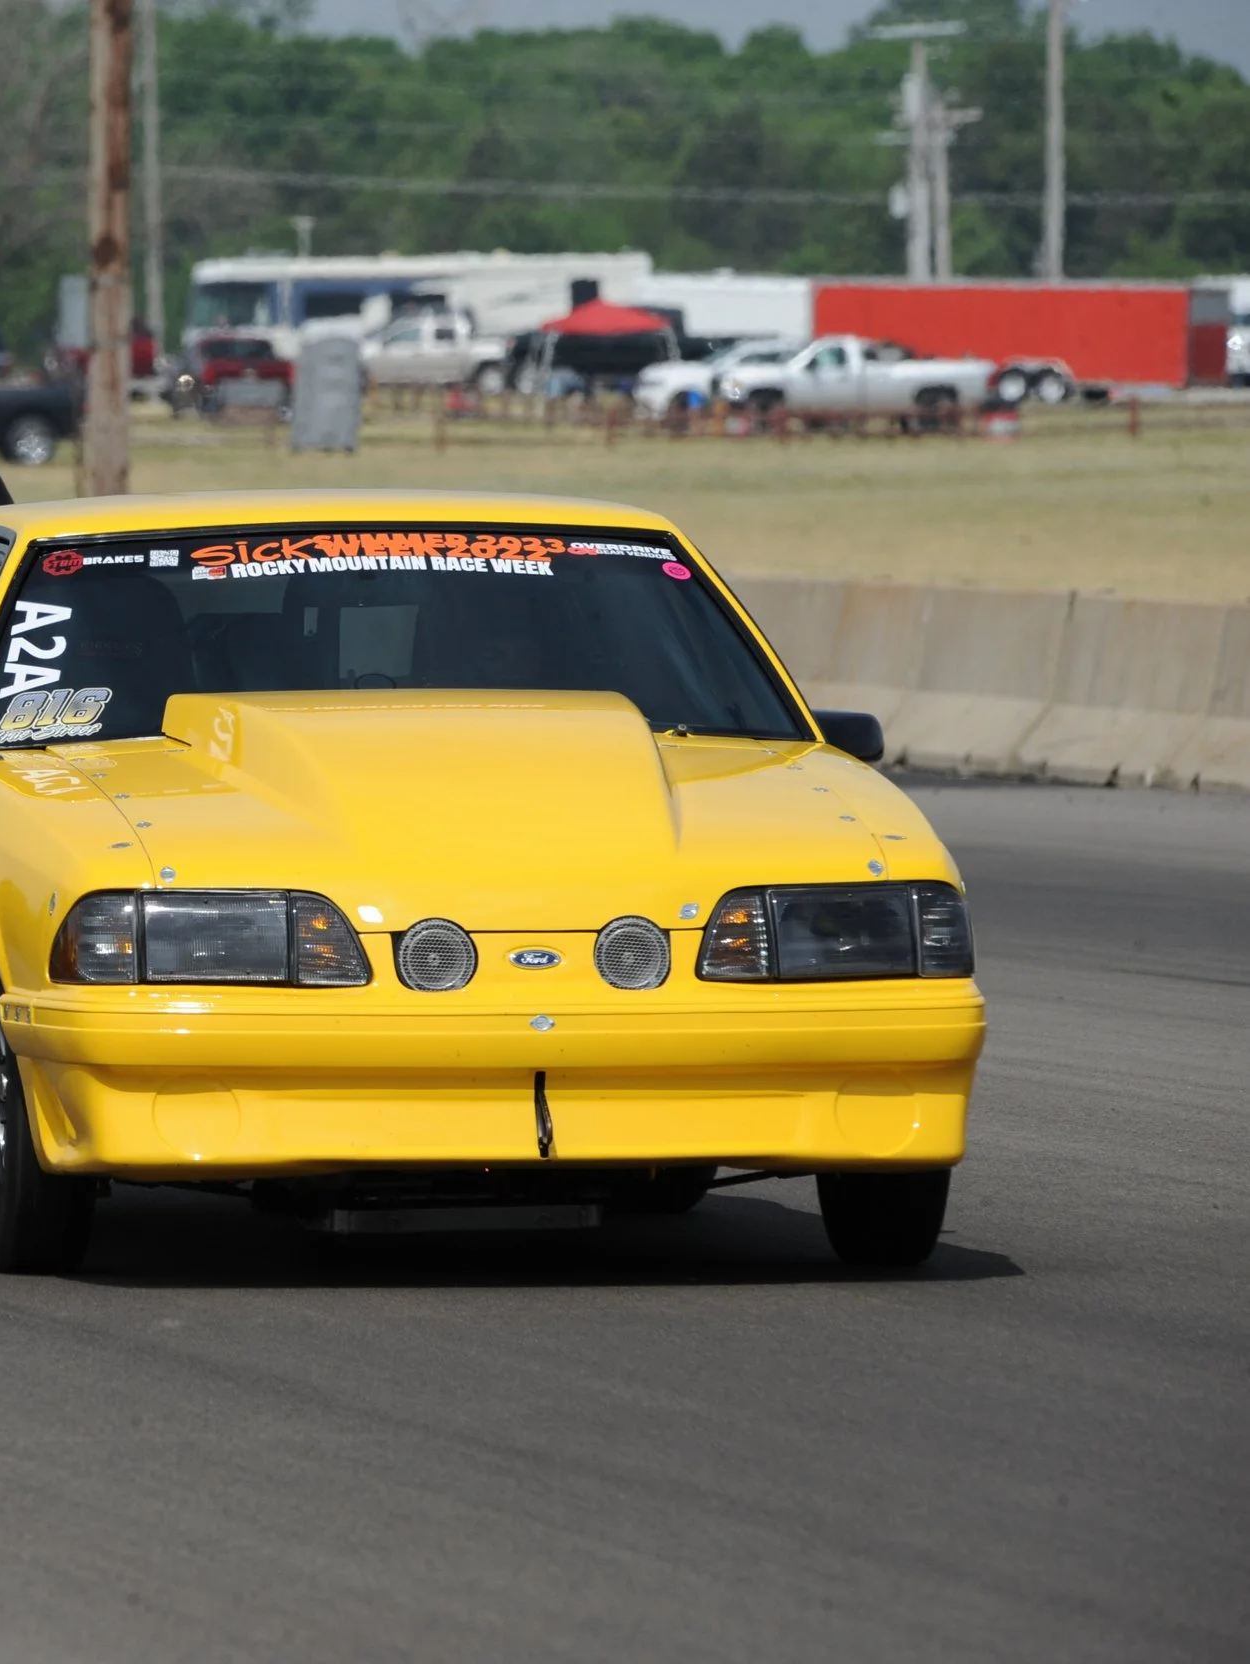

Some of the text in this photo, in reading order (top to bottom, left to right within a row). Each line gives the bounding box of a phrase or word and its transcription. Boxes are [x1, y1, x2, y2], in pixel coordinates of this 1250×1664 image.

[570, 542, 673, 556] OVERDRIVE
[83, 555, 144, 566] BRAKES
[230, 558, 307, 578] ROCKY
[308, 555, 427, 573] MOUNTAIN
[430, 556, 489, 572] RACE
[491, 558, 554, 576] WEEK
[0, 600, 72, 699] A2A
[32, 723, 102, 740] Street
[520, 953, 549, 964] Ford
